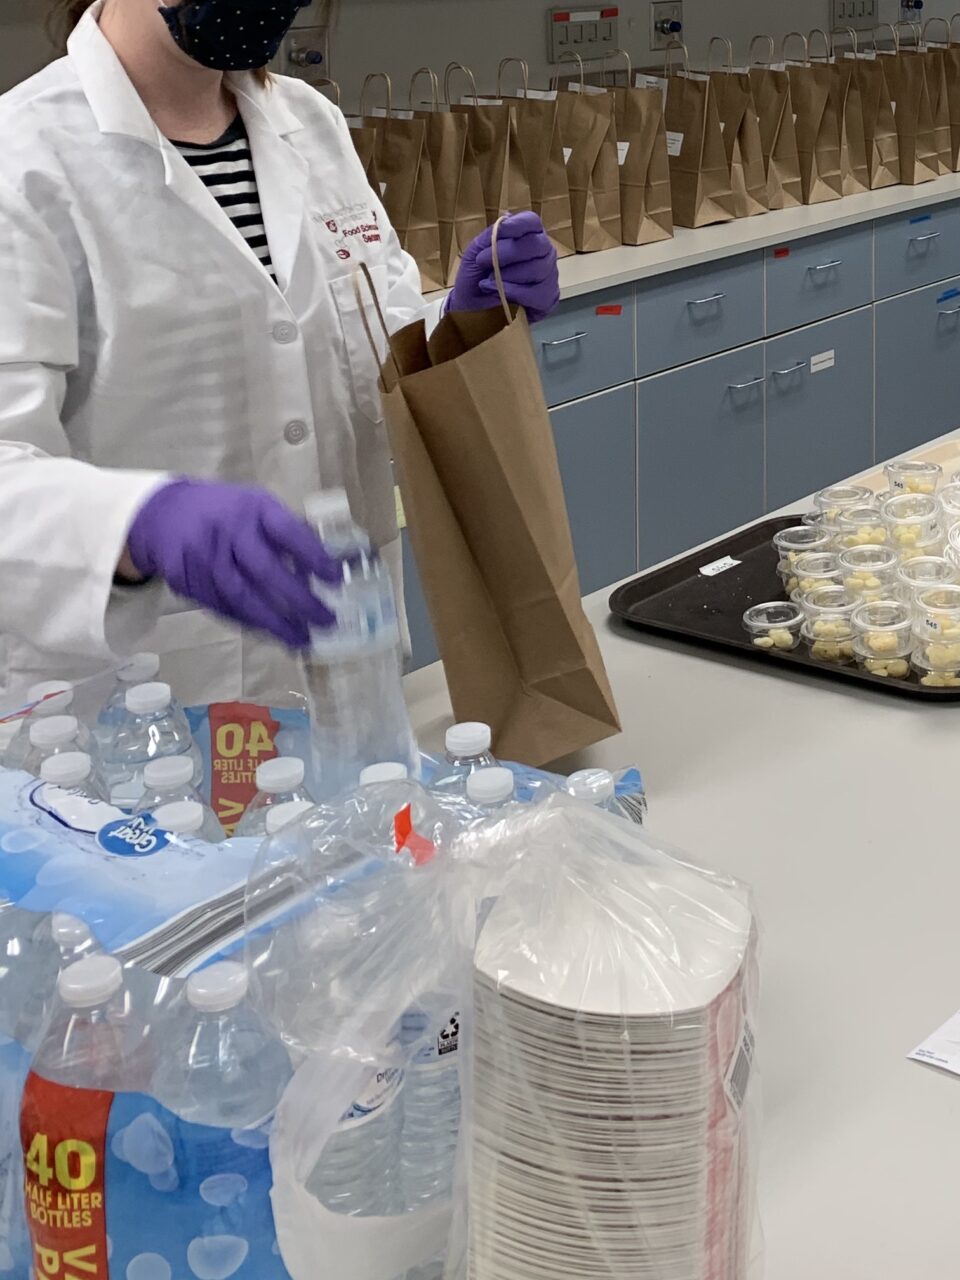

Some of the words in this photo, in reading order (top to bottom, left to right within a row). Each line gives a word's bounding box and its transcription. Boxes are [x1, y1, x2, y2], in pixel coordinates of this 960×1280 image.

[27, 1132, 96, 1190] 40
[25, 1183, 52, 1207] HALF
[57, 1192, 103, 1210] LITER
[30, 1202, 92, 1228] BOTTLES
